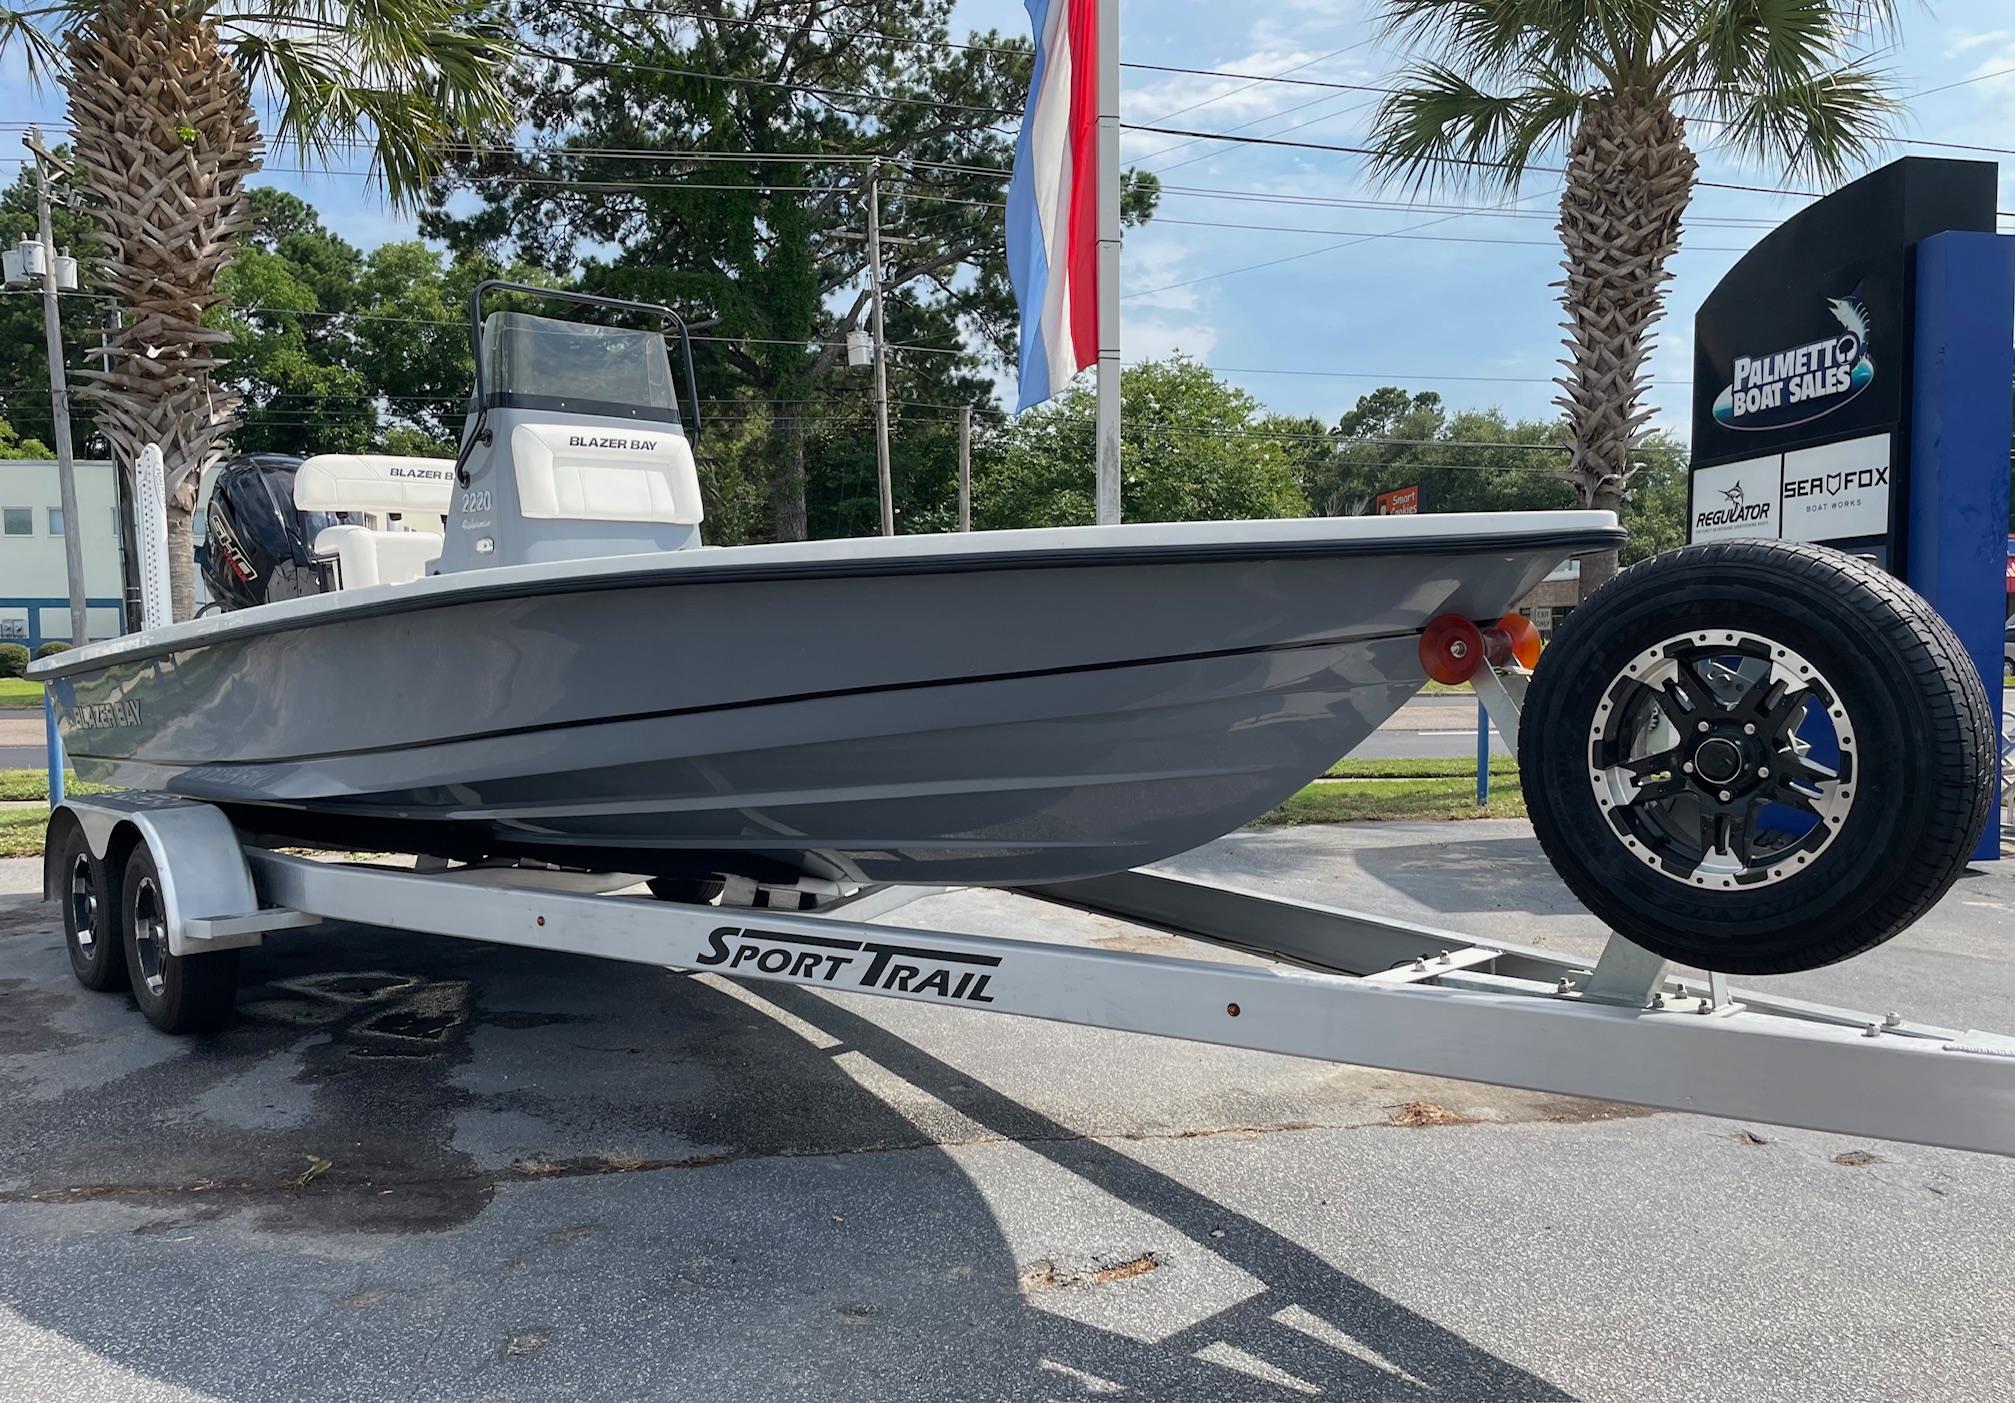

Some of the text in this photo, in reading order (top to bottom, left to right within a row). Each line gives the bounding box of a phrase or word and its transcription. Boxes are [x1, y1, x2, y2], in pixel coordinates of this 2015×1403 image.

[1734, 334, 1858, 391] PALMETTO
[1733, 365, 1851, 417] BOAT SALES
[569, 436, 657, 451] BLAZER BAY
[390, 468, 441, 480] BLAZER
[1784, 466, 1888, 499] SEA FOX
[462, 490, 492, 513] 2220
[1392, 491, 1415, 506] Smart
[1806, 499, 1862, 513] BOAT WORKS
[1696, 502, 1770, 528] REGULATOR
[73, 699, 143, 729] BLAZER BAY
[696, 927, 1003, 1003] SPORT TRAIL
